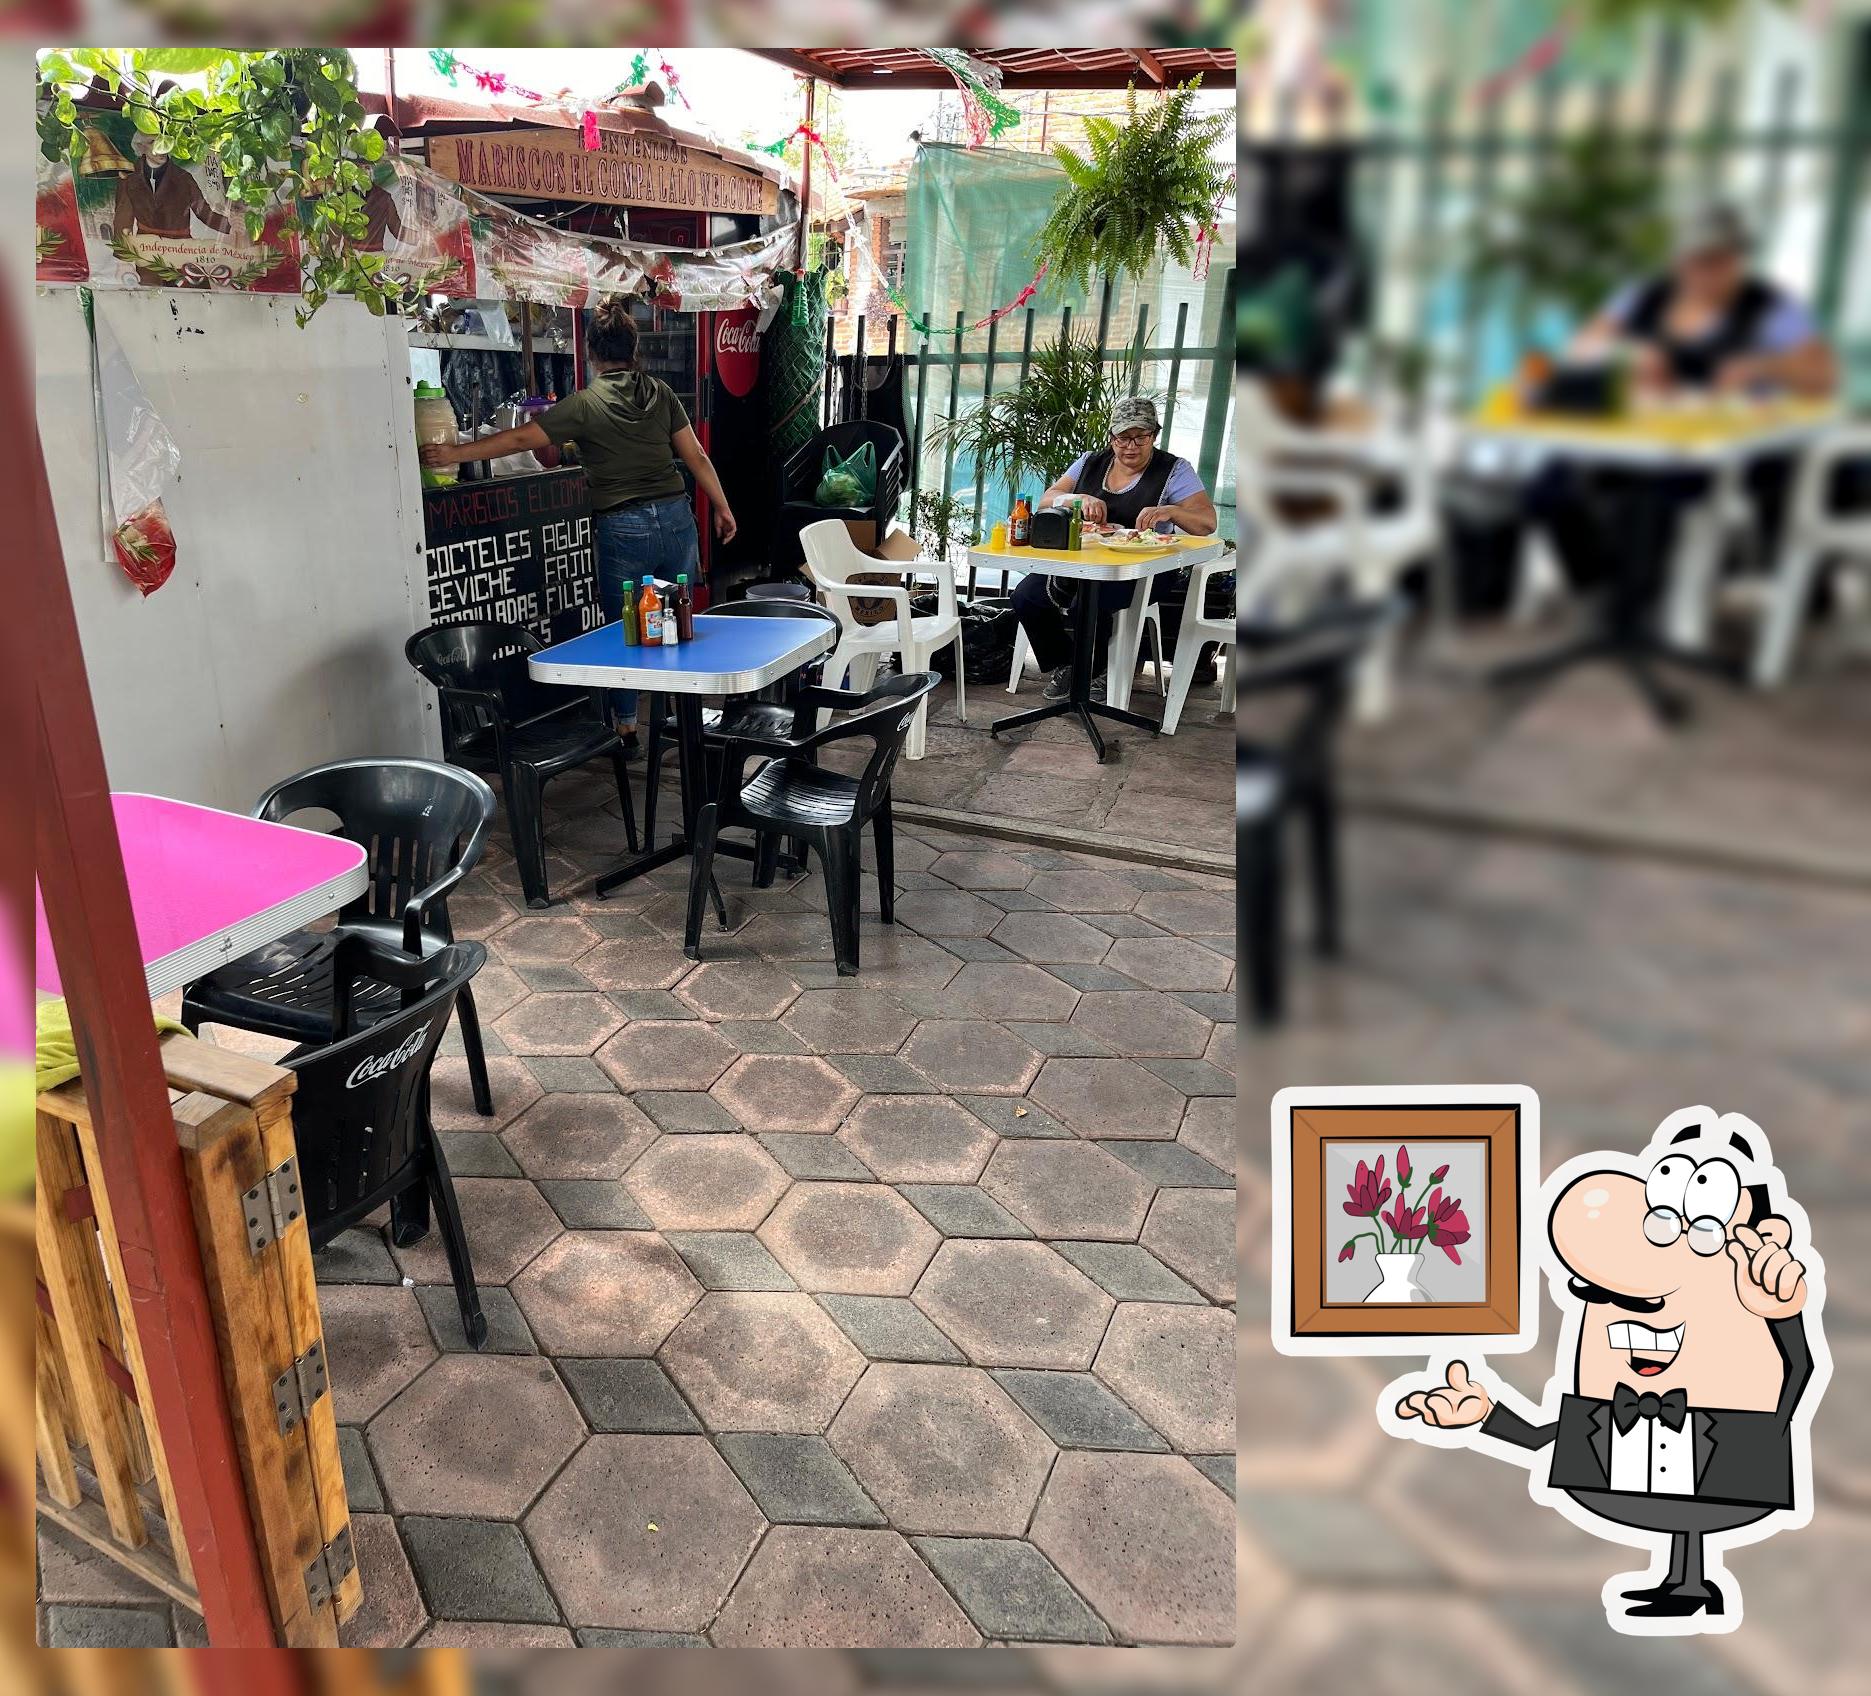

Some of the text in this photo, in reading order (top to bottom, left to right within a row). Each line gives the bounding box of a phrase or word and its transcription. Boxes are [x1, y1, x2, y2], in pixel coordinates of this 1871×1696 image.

[578, 130, 688, 165] BENVENIDOS
[456, 138, 566, 193] MARISCOS
[570, 154, 593, 195] EL
[597, 158, 655, 202] COMPA
[658, 165, 697, 207] LALO
[700, 170, 763, 212] WELCOME
[139, 242, 208, 256] Independencia
[209, 244, 221, 254] de
[195, 255, 216, 264] 1810
[428, 487, 519, 529] MARISCOS
[552, 477, 588, 510] COMP
[542, 517, 592, 553] AGUA
[426, 529, 531, 580] COCTELES
[544, 548, 592, 584] FAJIT
[428, 566, 517, 613] CEVICHE
[546, 577, 593, 615] FILET
[345, 1016, 434, 1089] Coca-Cola
